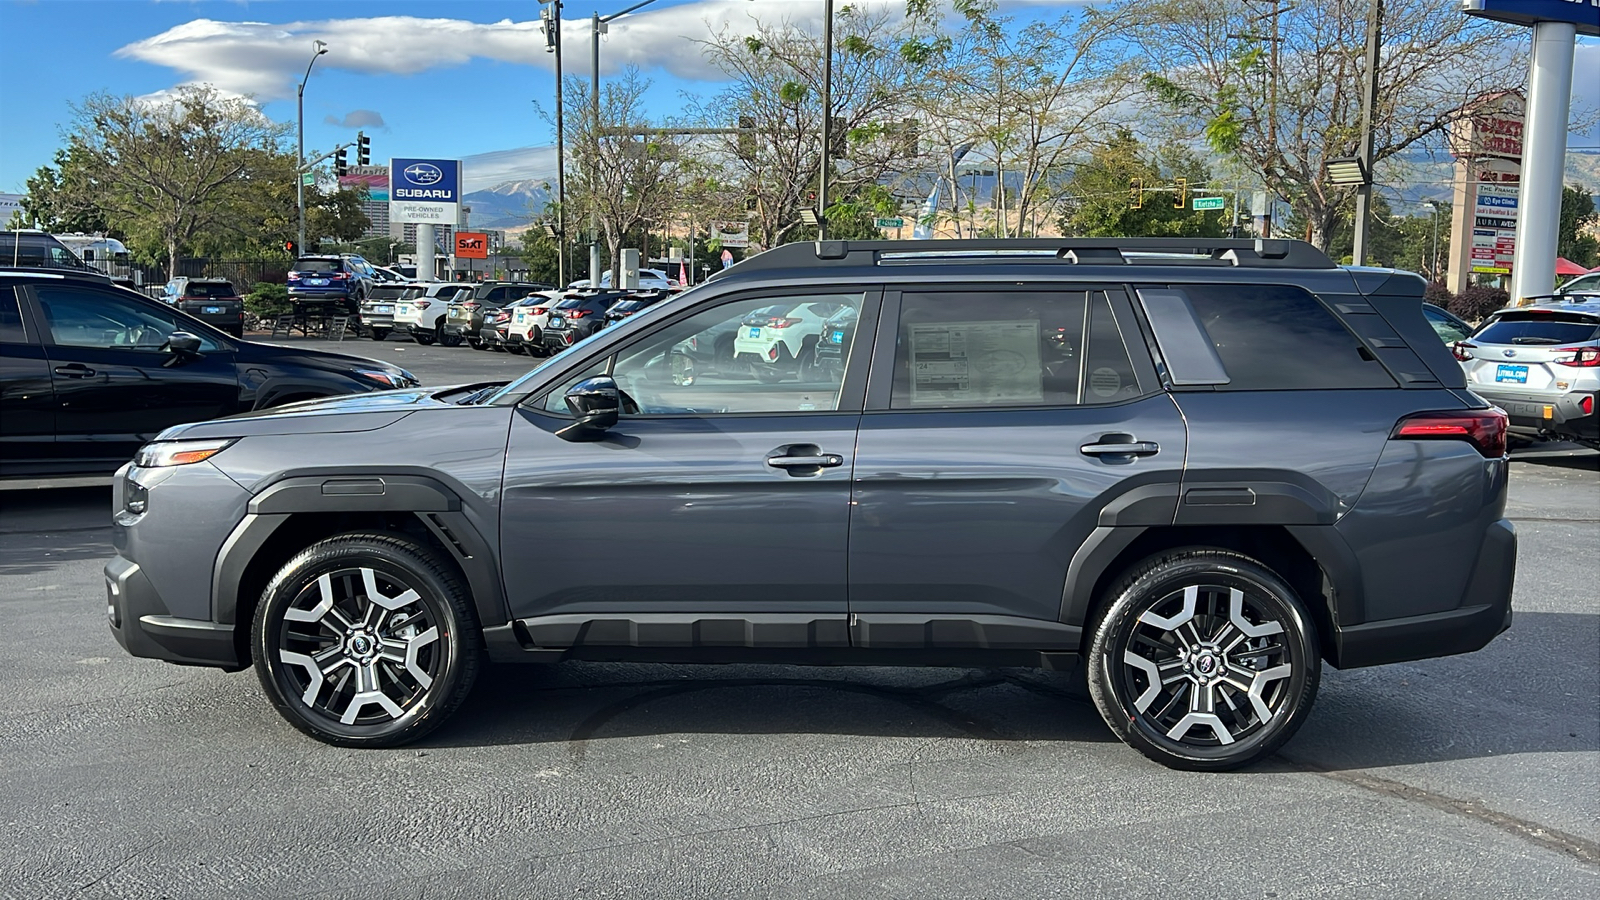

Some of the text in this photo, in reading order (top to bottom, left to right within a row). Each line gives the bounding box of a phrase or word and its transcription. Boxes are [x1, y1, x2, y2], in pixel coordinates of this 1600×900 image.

[349, 166, 387, 176] Atlantis
[396, 188, 452, 199] SUBARU
[1502, 198, 1515, 206] Clinic
[1476, 218, 1497, 226] AURA
